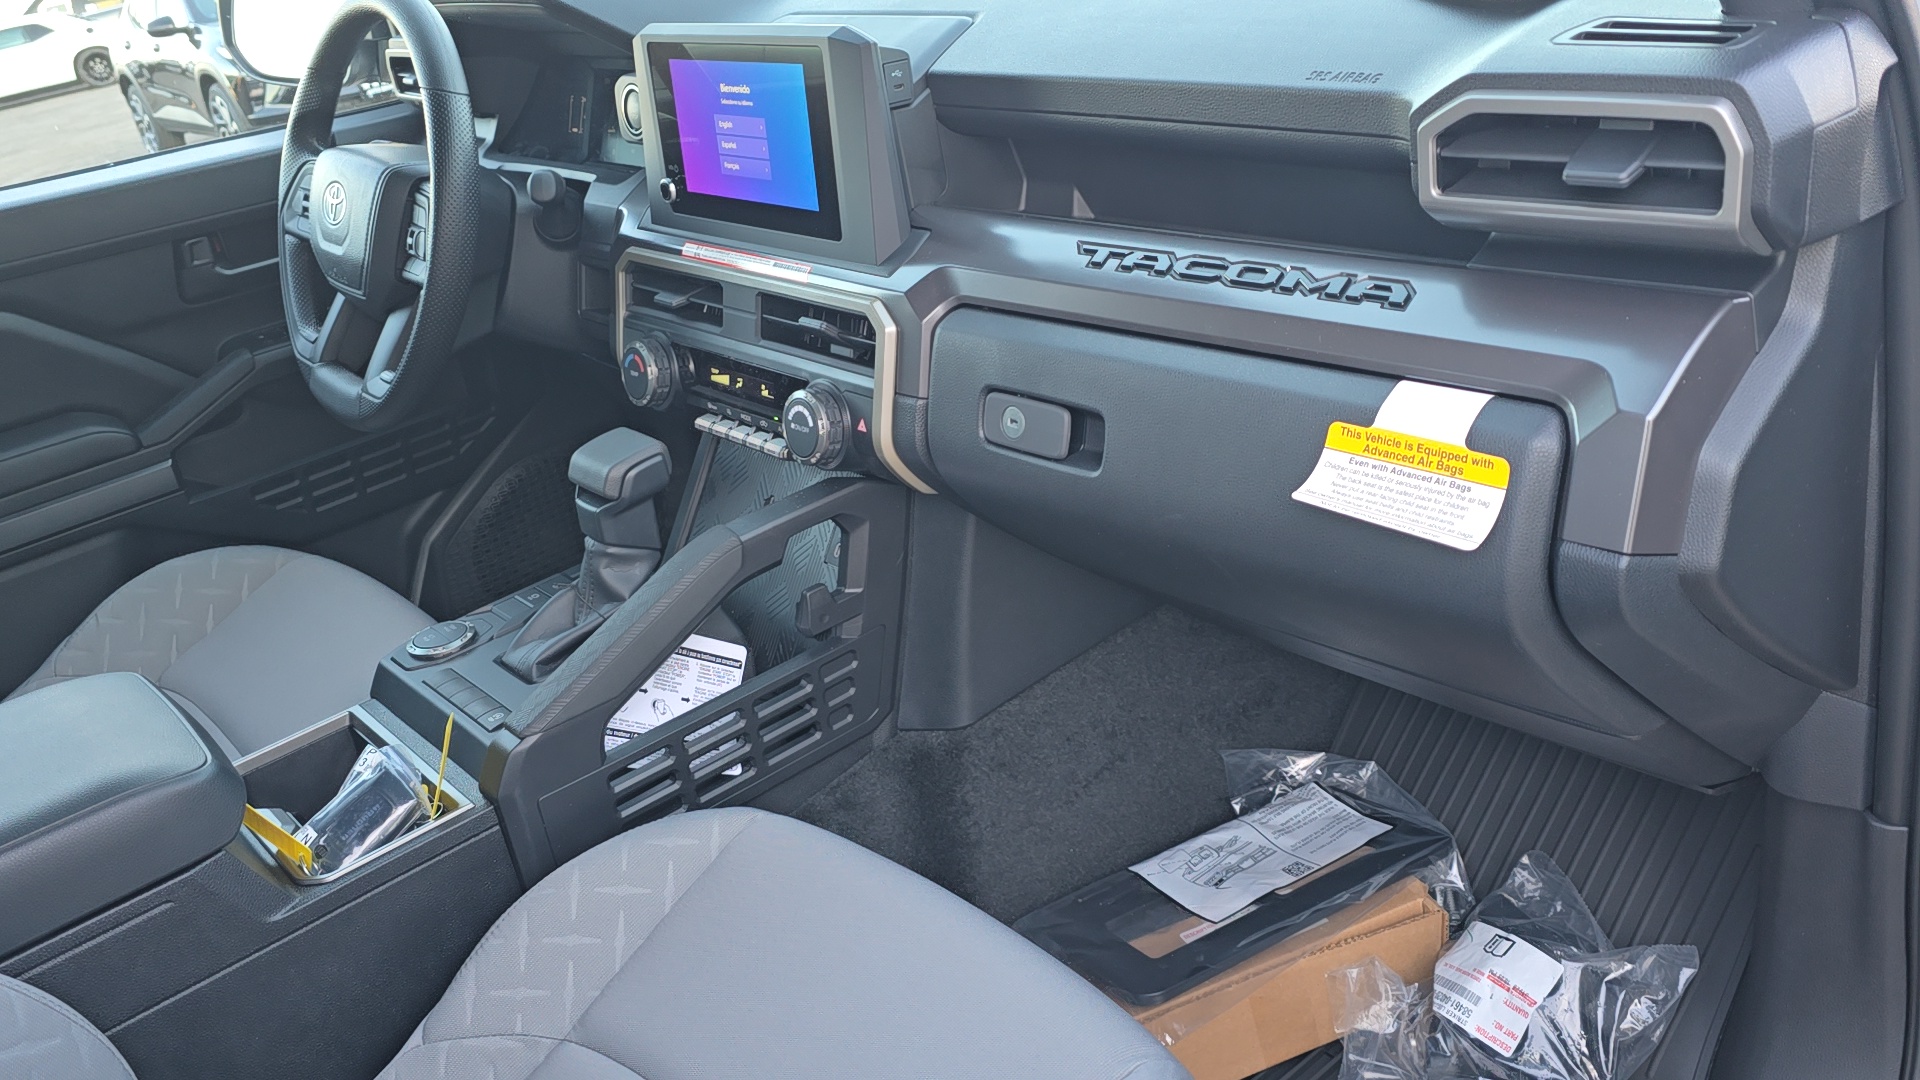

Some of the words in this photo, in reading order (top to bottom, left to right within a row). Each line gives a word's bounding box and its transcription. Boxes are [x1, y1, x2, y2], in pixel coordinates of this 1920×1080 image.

[1328, 71, 1384, 84] AIRBAG
[720, 83, 750, 94] Bienvenido
[719, 121, 732, 129] English
[721, 140, 737, 149] Español
[724, 162, 740, 170] Français
[1076, 240, 1417, 312] TACOMA
[1339, 426, 1362, 439] This
[1365, 431, 1401, 448] Vehicle
[1403, 440, 1414, 451] is
[1416, 443, 1468, 467] Equipped
[1470, 455, 1495, 469] with
[1362, 443, 1415, 464] Advanced
[1417, 455, 1433, 468] Air
[1435, 460, 1464, 477] Bags
[1323, 460, 1348, 472] Children
[1348, 467, 1360, 475] can
[1423, 485, 1445, 497] injured
[1446, 491, 1454, 499] by
[1455, 493, 1466, 501] the
[1476, 499, 1490, 508] bag
[1348, 456, 1369, 468] Even
[1370, 461, 1388, 472] with
[1390, 466, 1432, 483] Advanced
[1434, 476, 1446, 486] Air
[1448, 480, 1471, 494] Bags
[1335, 472, 1346, 481] The
[1347, 475, 1362, 484] back
[1363, 480, 1376, 488] seat
[1414, 493, 1432, 503] place
[1503, 997, 1529, 1018] QUANTITY:
[1446, 1010, 1468, 1026] STRIKER
[1491, 1020, 1504, 1030] NO.:
[1474, 1024, 1512, 1052] DESCRIPTION:
[1503, 1027, 1519, 1041] PART
